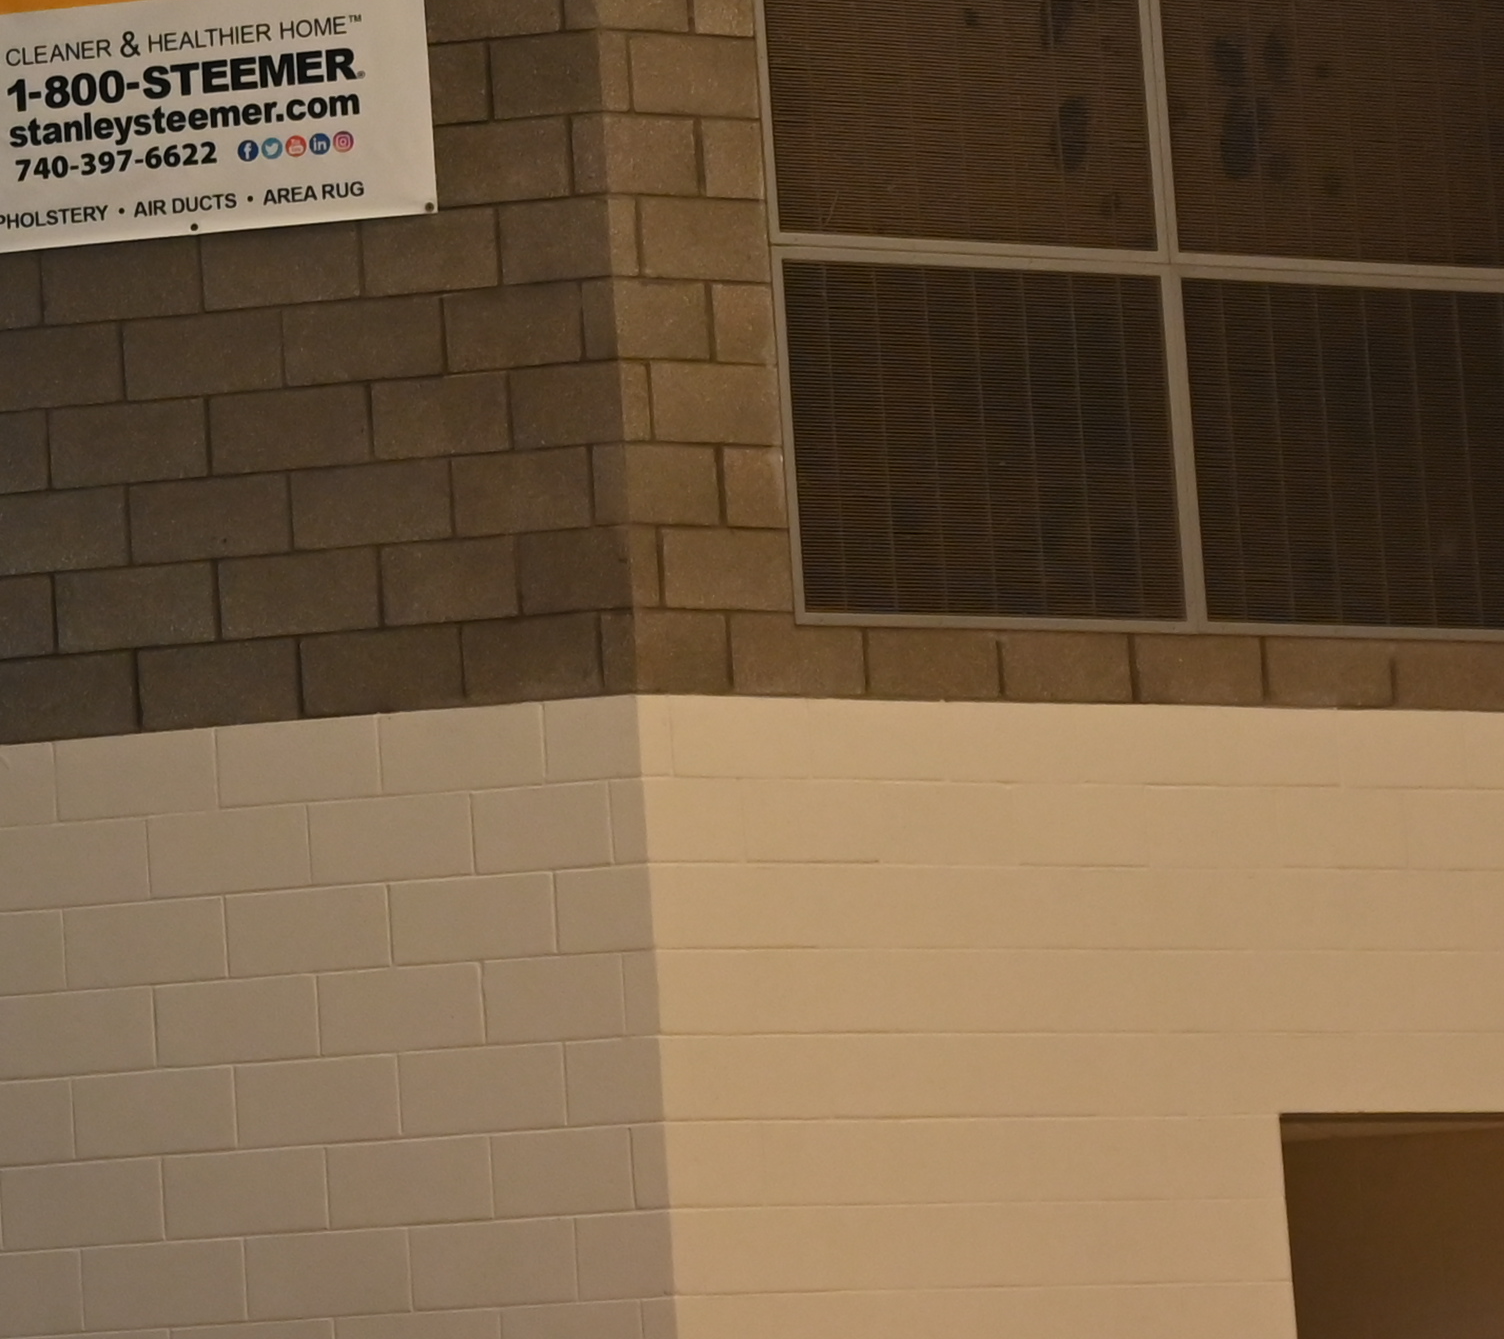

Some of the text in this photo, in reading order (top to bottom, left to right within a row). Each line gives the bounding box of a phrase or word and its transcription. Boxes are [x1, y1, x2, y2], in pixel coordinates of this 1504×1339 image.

[5, 38, 112, 67] CLEANER
[119, 31, 142, 59] &
[147, 22, 272, 54] HEALTHIER
[6, 47, 358, 113] 1-800-STEEMER
[9, 92, 361, 148] stanleysteemer.com
[15, 140, 218, 182] 740-397-6622
[133, 198, 165, 218] AIR
[168, 192, 239, 215] DUCTS
[263, 184, 317, 206] AREA
[322, 180, 366, 201] RUG
